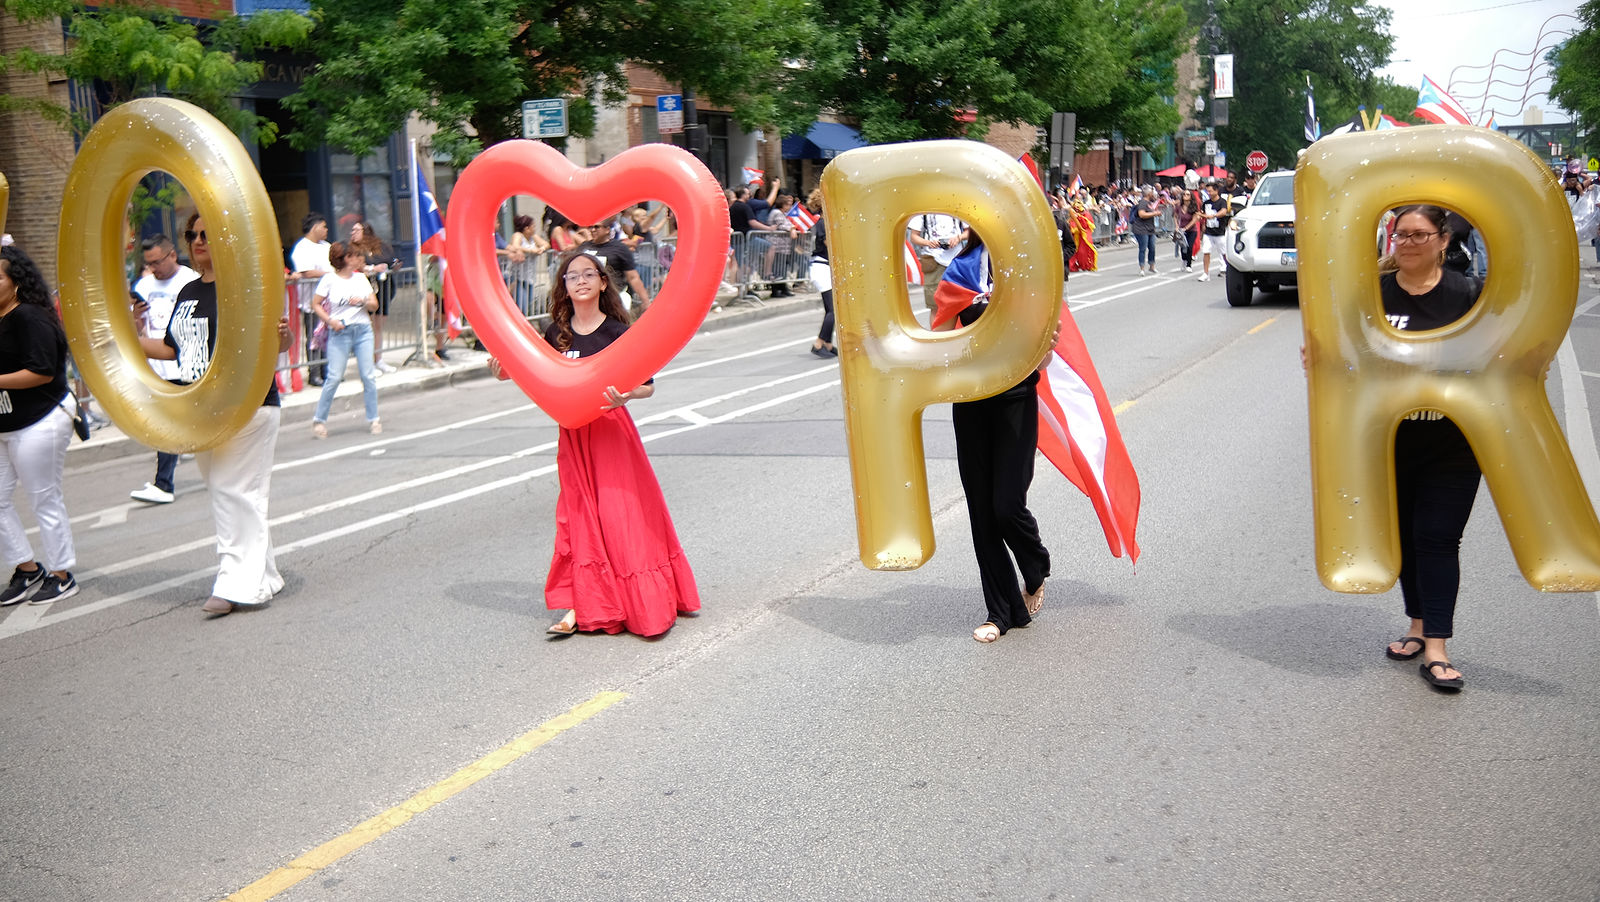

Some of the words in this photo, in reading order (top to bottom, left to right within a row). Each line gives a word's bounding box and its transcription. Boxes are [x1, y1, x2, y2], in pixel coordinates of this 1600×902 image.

[1248, 156, 1267, 168] STOP
[821, 139, 1063, 572] P
[1294, 124, 1600, 594] R
